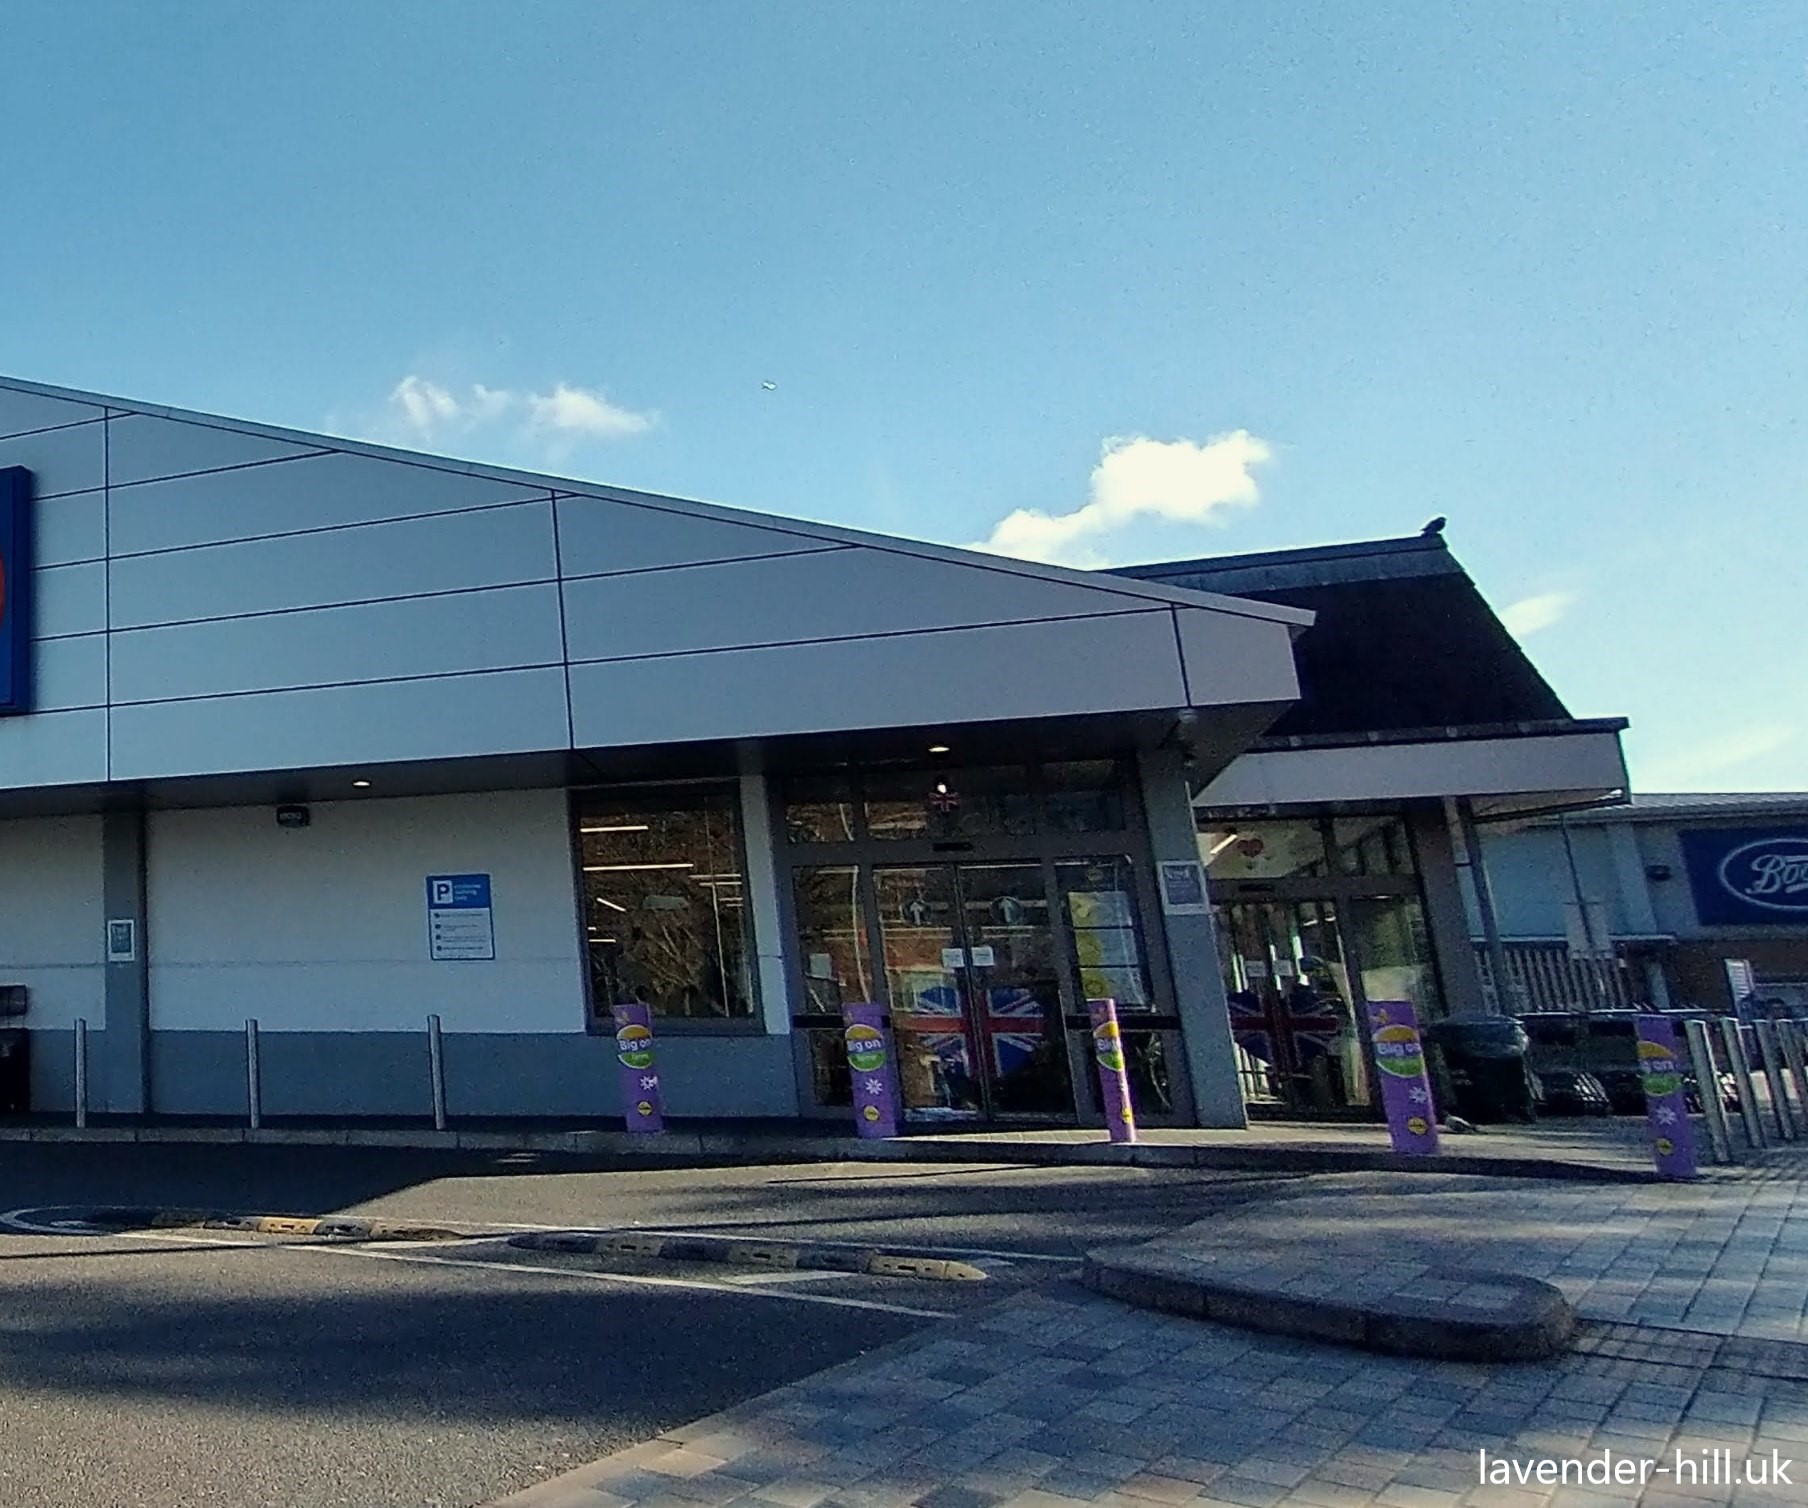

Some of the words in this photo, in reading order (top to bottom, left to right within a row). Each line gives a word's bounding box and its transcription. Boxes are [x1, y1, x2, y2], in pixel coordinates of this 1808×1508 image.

[437, 883, 450, 901] P
[619, 1040, 638, 1052] Big
[864, 1039, 882, 1049] on
